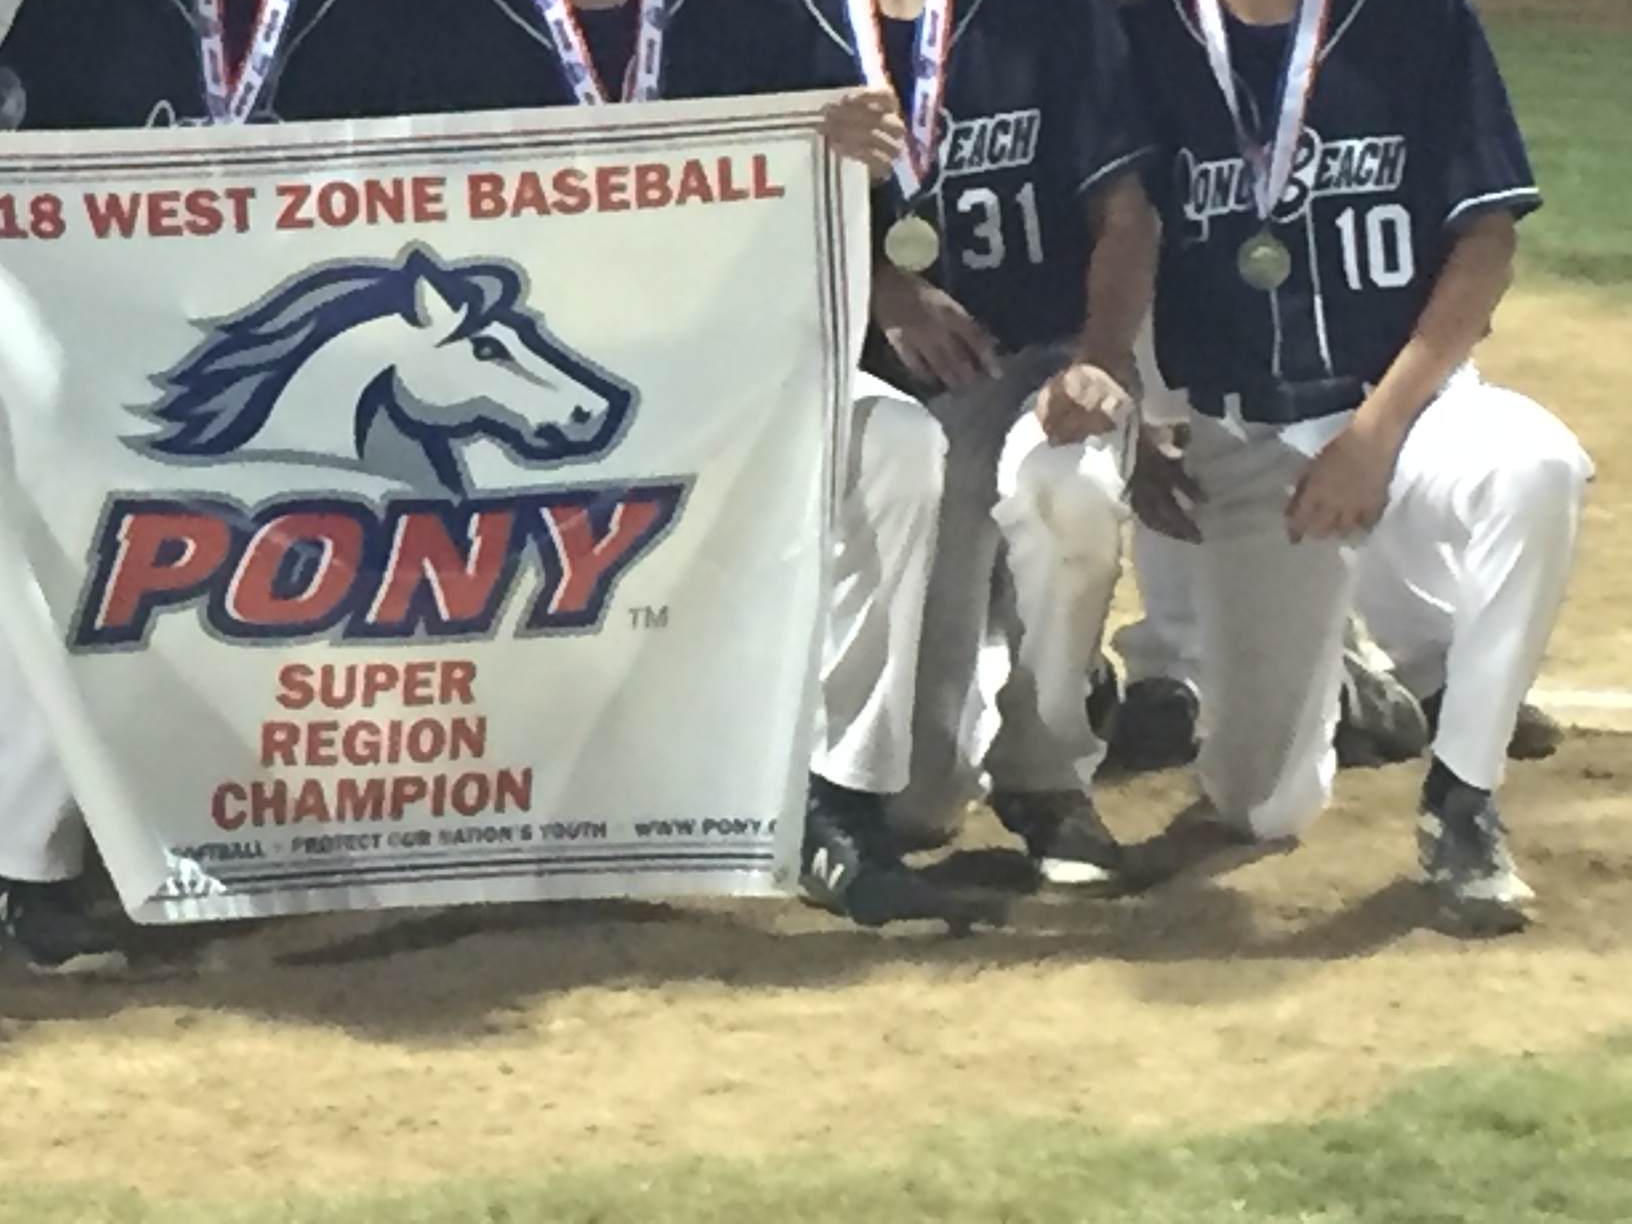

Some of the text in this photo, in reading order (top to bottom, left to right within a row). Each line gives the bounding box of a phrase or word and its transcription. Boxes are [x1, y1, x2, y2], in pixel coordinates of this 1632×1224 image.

[83, 187, 257, 239] WEST
[275, 176, 448, 231] ZONE
[467, 154, 786, 220] BASEBALL
[1272, 126, 1406, 224] BEACH
[957, 182, 1044, 269] 31
[1335, 204, 1415, 290] 10
[76, 484, 684, 644] PONY TM
[275, 660, 478, 709] SUPER
[260, 716, 488, 767] REGION
[211, 767, 534, 831] CHAMPION
[540, 821, 608, 840] YOUTH
